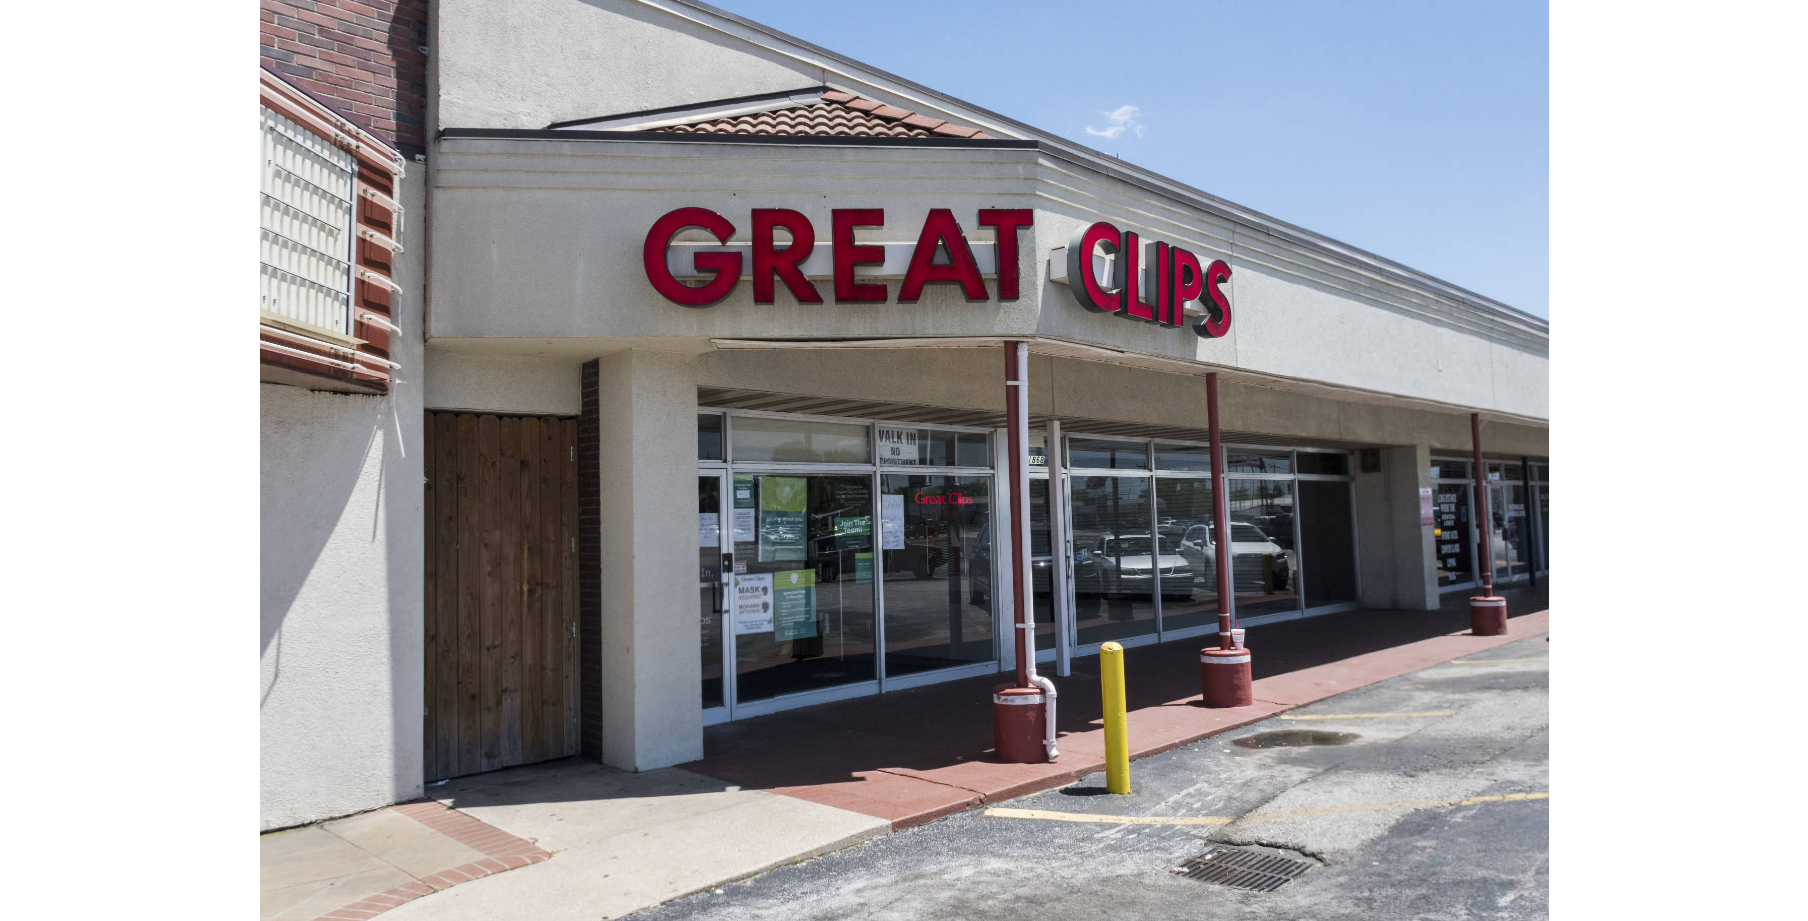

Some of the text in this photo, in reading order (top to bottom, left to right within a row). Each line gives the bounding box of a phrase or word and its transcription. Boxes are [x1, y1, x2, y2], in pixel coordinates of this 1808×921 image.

[643, 207, 1232, 338] GREAT CLIPS
[906, 431, 917, 445] IN
[890, 447, 901, 456] NO
[879, 457, 917, 466] PPOINTMENT
[914, 492, 946, 505] Great
[948, 492, 973, 508] Clips
[738, 586, 760, 594] MASK
